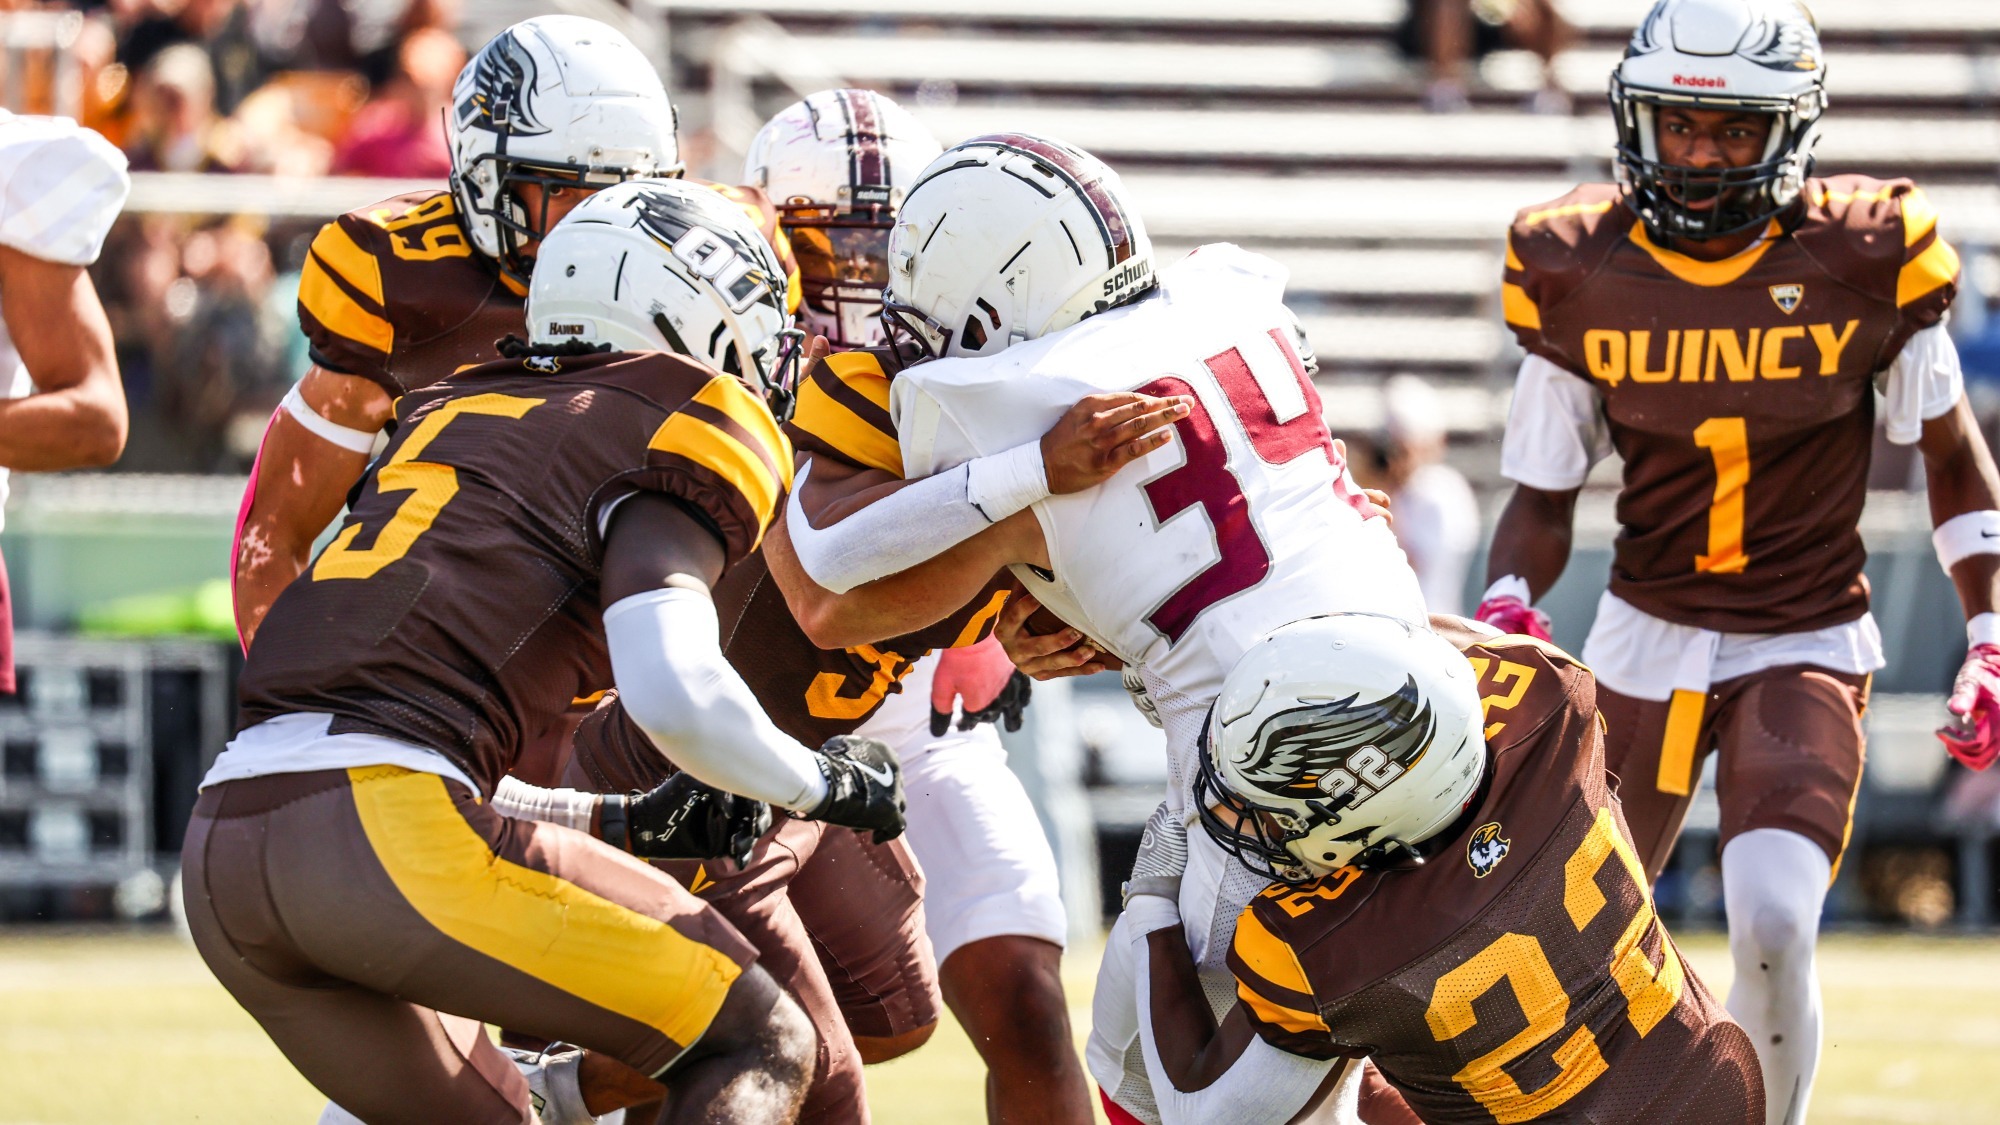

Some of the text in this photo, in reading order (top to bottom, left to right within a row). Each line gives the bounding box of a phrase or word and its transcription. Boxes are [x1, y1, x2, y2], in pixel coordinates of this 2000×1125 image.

[1672, 74, 1726, 89] Riddell
[857, 188, 890, 201] schutt
[671, 225, 769, 315] QU
[1103, 257, 1150, 297] schutt
[1584, 319, 1860, 388] QUINCY
[312, 392, 547, 582] 5
[1128, 327, 1378, 652] 34
[1693, 417, 1749, 574] 1
[1317, 744, 1407, 811] 22
[1424, 807, 1685, 1125] 22
